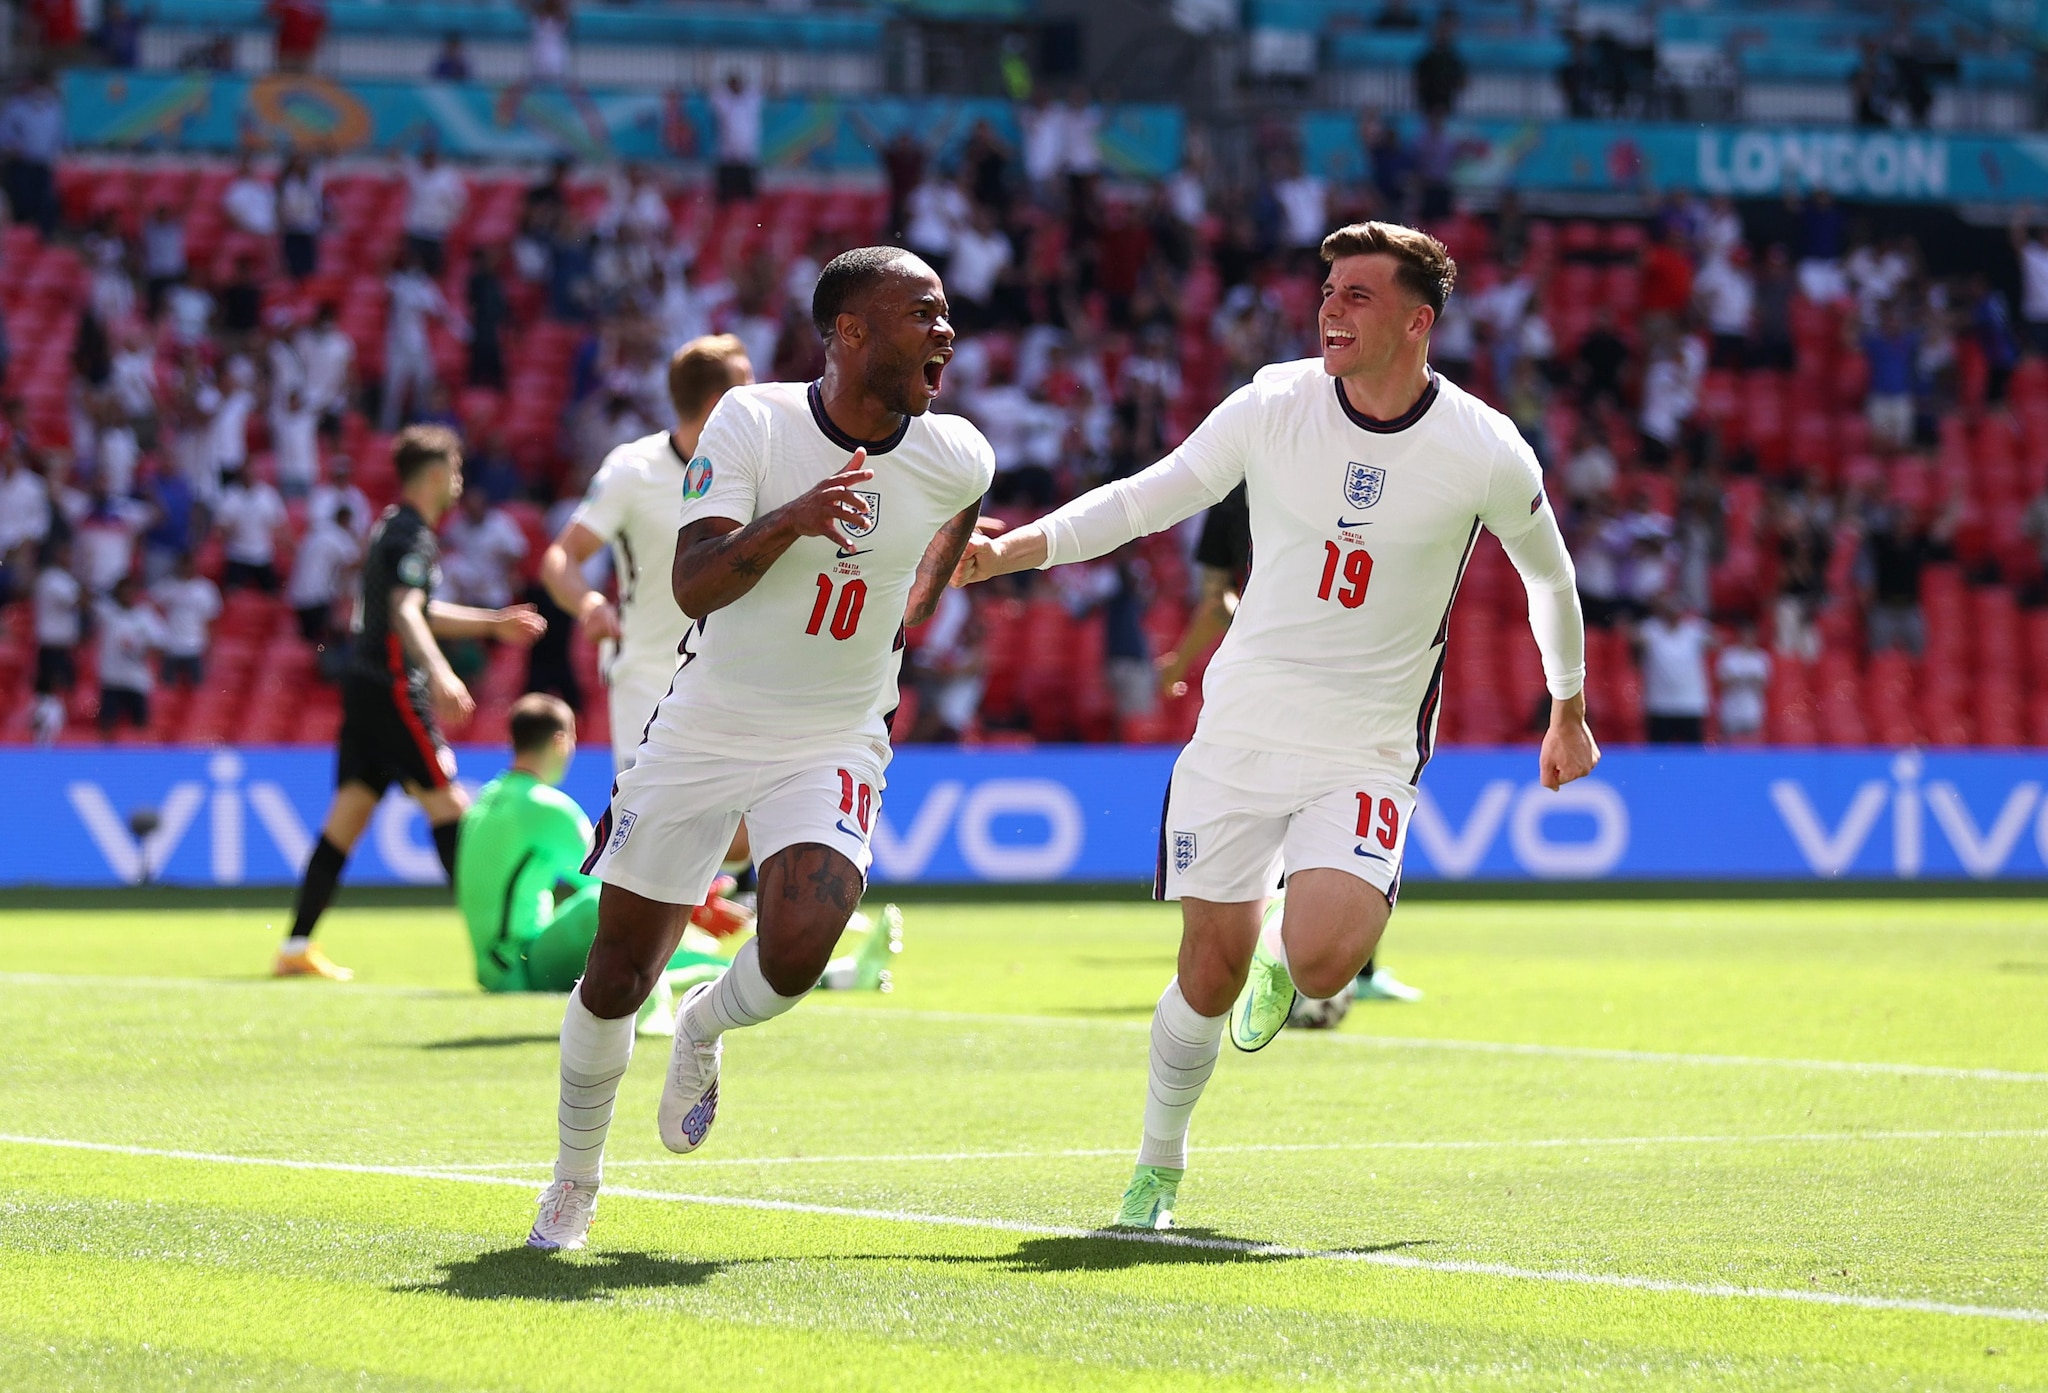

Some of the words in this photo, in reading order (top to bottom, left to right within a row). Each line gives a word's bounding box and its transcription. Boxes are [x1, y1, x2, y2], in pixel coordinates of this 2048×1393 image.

[1698, 131, 1948, 194] LONDON
[838, 561, 859, 569] CROATIA
[1341, 530, 1362, 539] CROATIA
[805, 573, 868, 641] 10
[1317, 540, 1374, 609] 19
[837, 768, 871, 835] 10
[868, 778, 1084, 881] vo
[1355, 791, 1399, 851] 19
[1410, 777, 1633, 880] vo
[1767, 748, 2048, 879] viv
